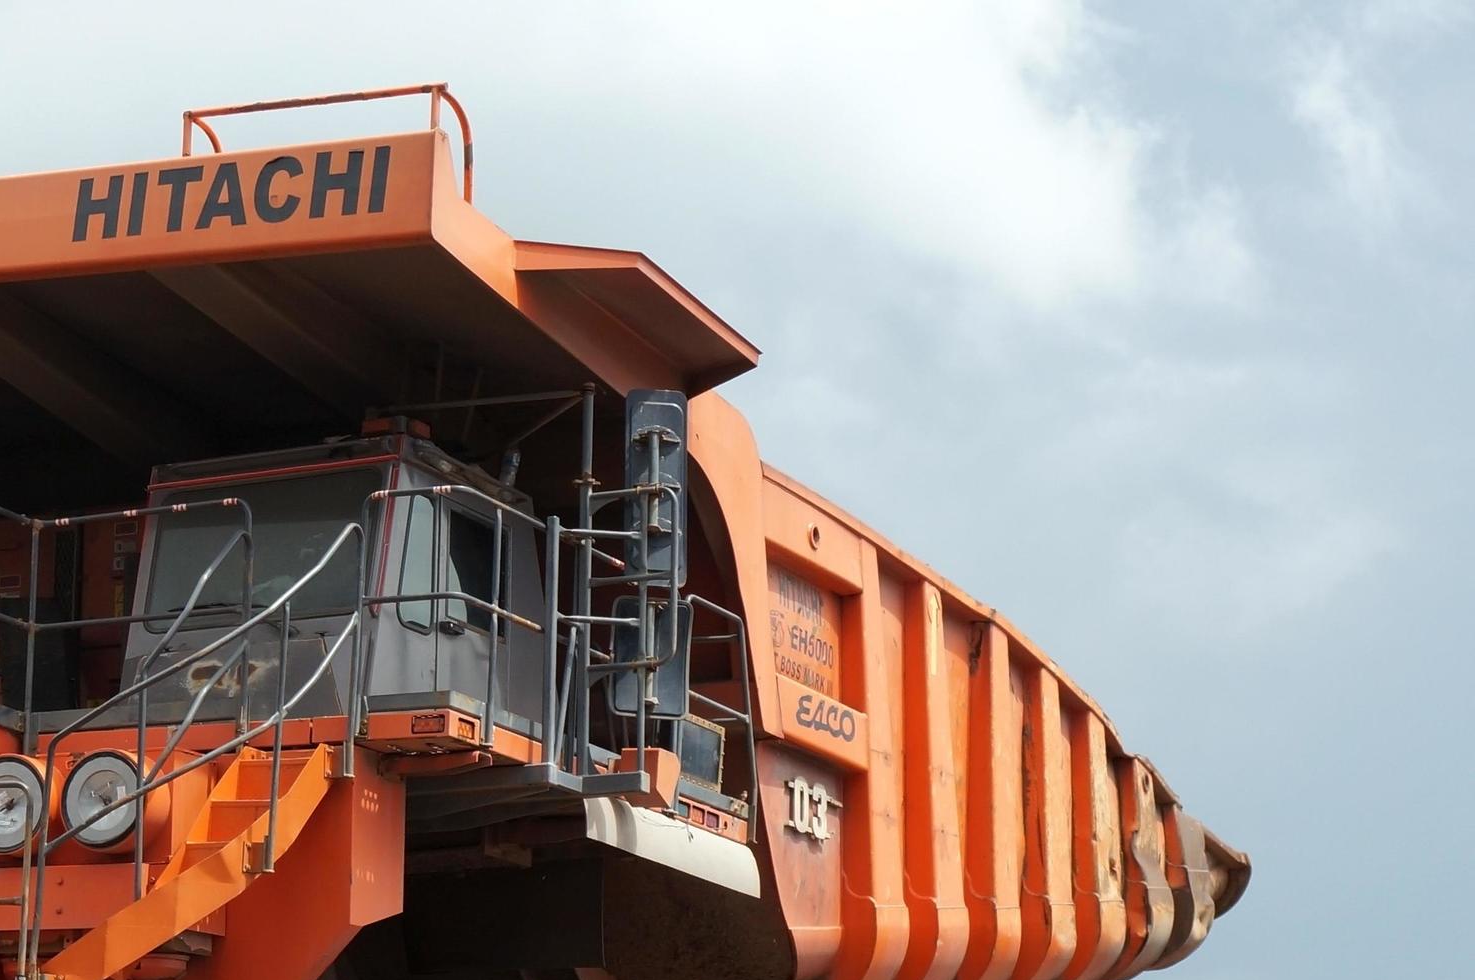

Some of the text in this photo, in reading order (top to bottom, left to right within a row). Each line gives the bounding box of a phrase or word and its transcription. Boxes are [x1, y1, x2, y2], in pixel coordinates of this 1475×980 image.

[72, 145, 391, 242] HITACHI
[781, 657, 802, 680] BOSS
[790, 625, 834, 669] EH5000
[794, 776, 828, 839] 03
